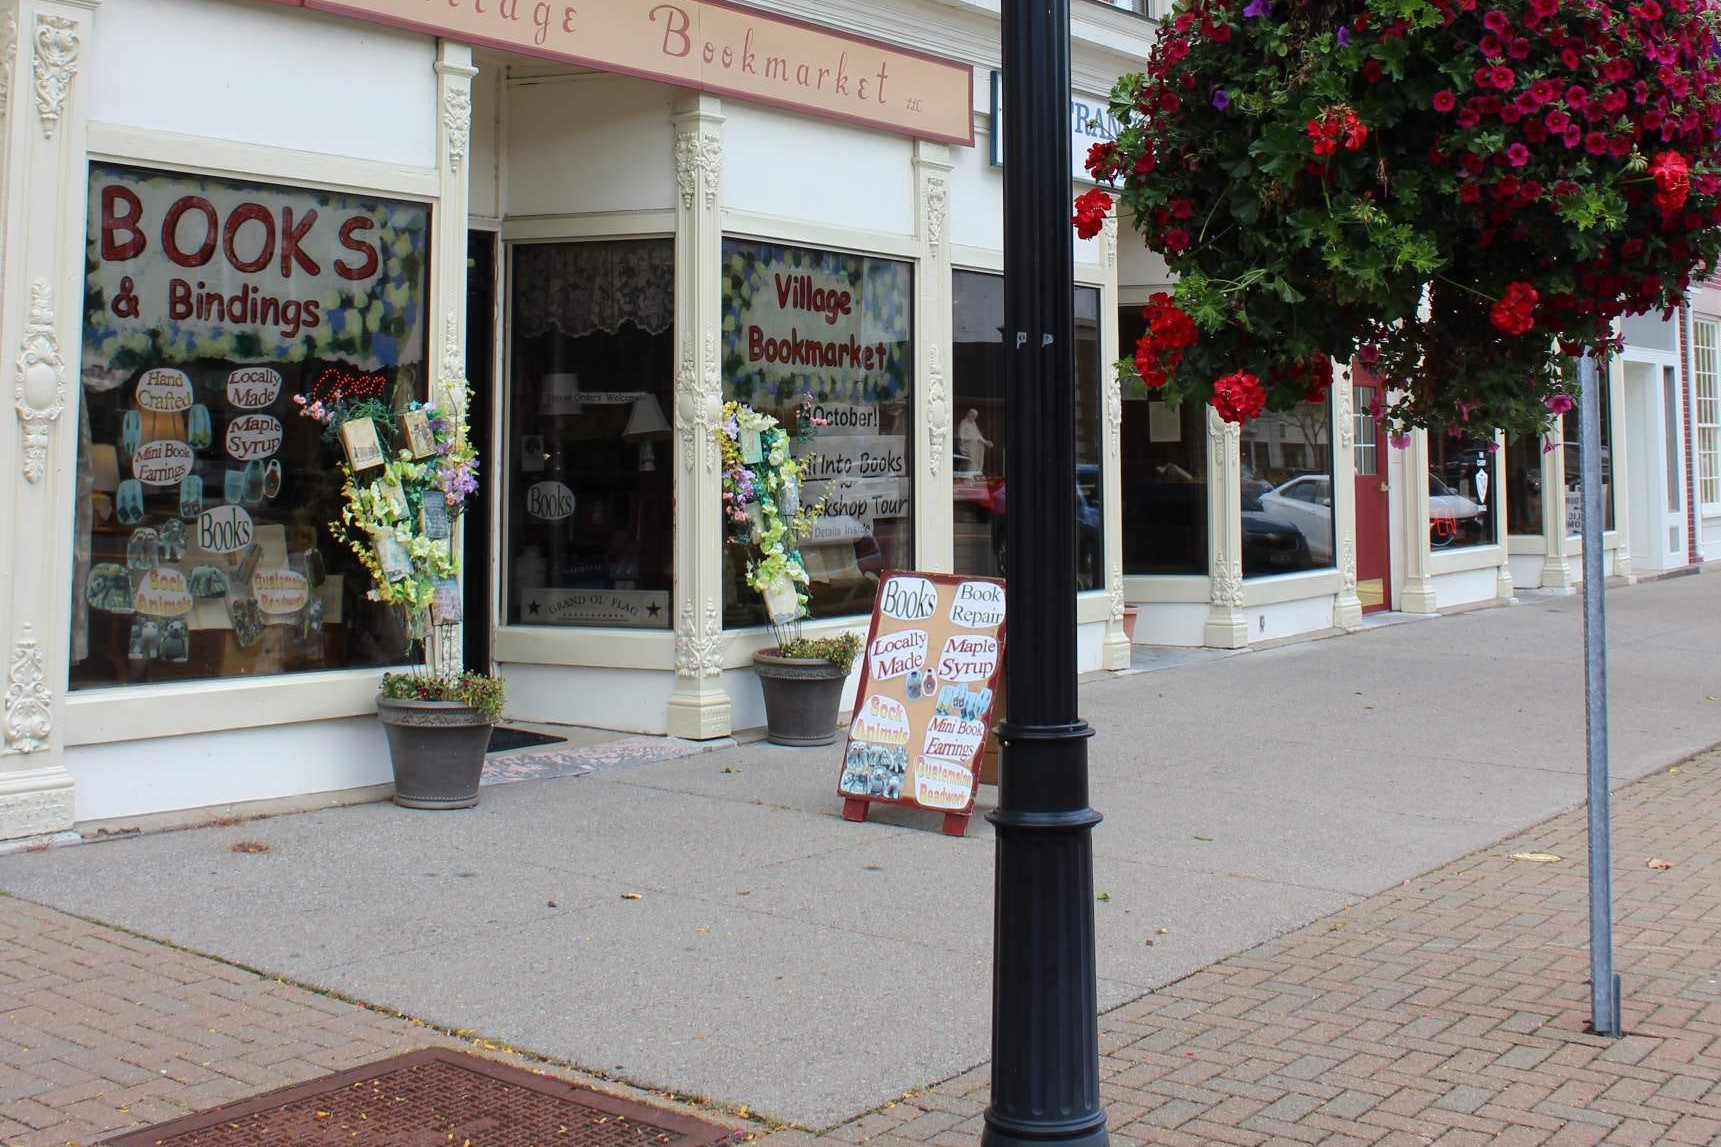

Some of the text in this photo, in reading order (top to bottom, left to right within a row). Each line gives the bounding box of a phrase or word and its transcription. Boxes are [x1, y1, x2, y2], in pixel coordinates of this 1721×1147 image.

[649, 4, 889, 104] Bookmarket
[101, 185, 380, 280] BOOKS
[111, 276, 320, 338] & Bindings
[775, 273, 851, 324] Village
[749, 325, 887, 371] Bookmarket
[148, 371, 183, 389] Hand
[230, 371, 280, 390] Locally
[138, 389, 193, 410] Crafted
[232, 388, 275, 408] Made
[230, 419, 281, 436] Maple
[813, 406, 877, 427] October!
[136, 444, 191, 463] Mini Book
[230, 434, 280, 456] Syrup
[138, 461, 187, 483] Earrings
[822, 453, 852, 474] Into
[860, 449, 902, 474] Books
[530, 484, 573, 517] Books
[872, 495, 908, 515] Tour
[201, 508, 251, 550] Books
[883, 579, 936, 620] Books
[960, 584, 1001, 602] Book
[549, 595, 586, 614] GRAND
[610, 596, 638, 616] FLAG
[952, 605, 1003, 626] Repair
[873, 632, 927, 656] Locally
[945, 638, 996, 657] Maple
[877, 652, 923, 680] Made
[939, 657, 993, 681] Syrup
[928, 717, 983, 736] Mini Book
[926, 736, 975, 762] Earrings
